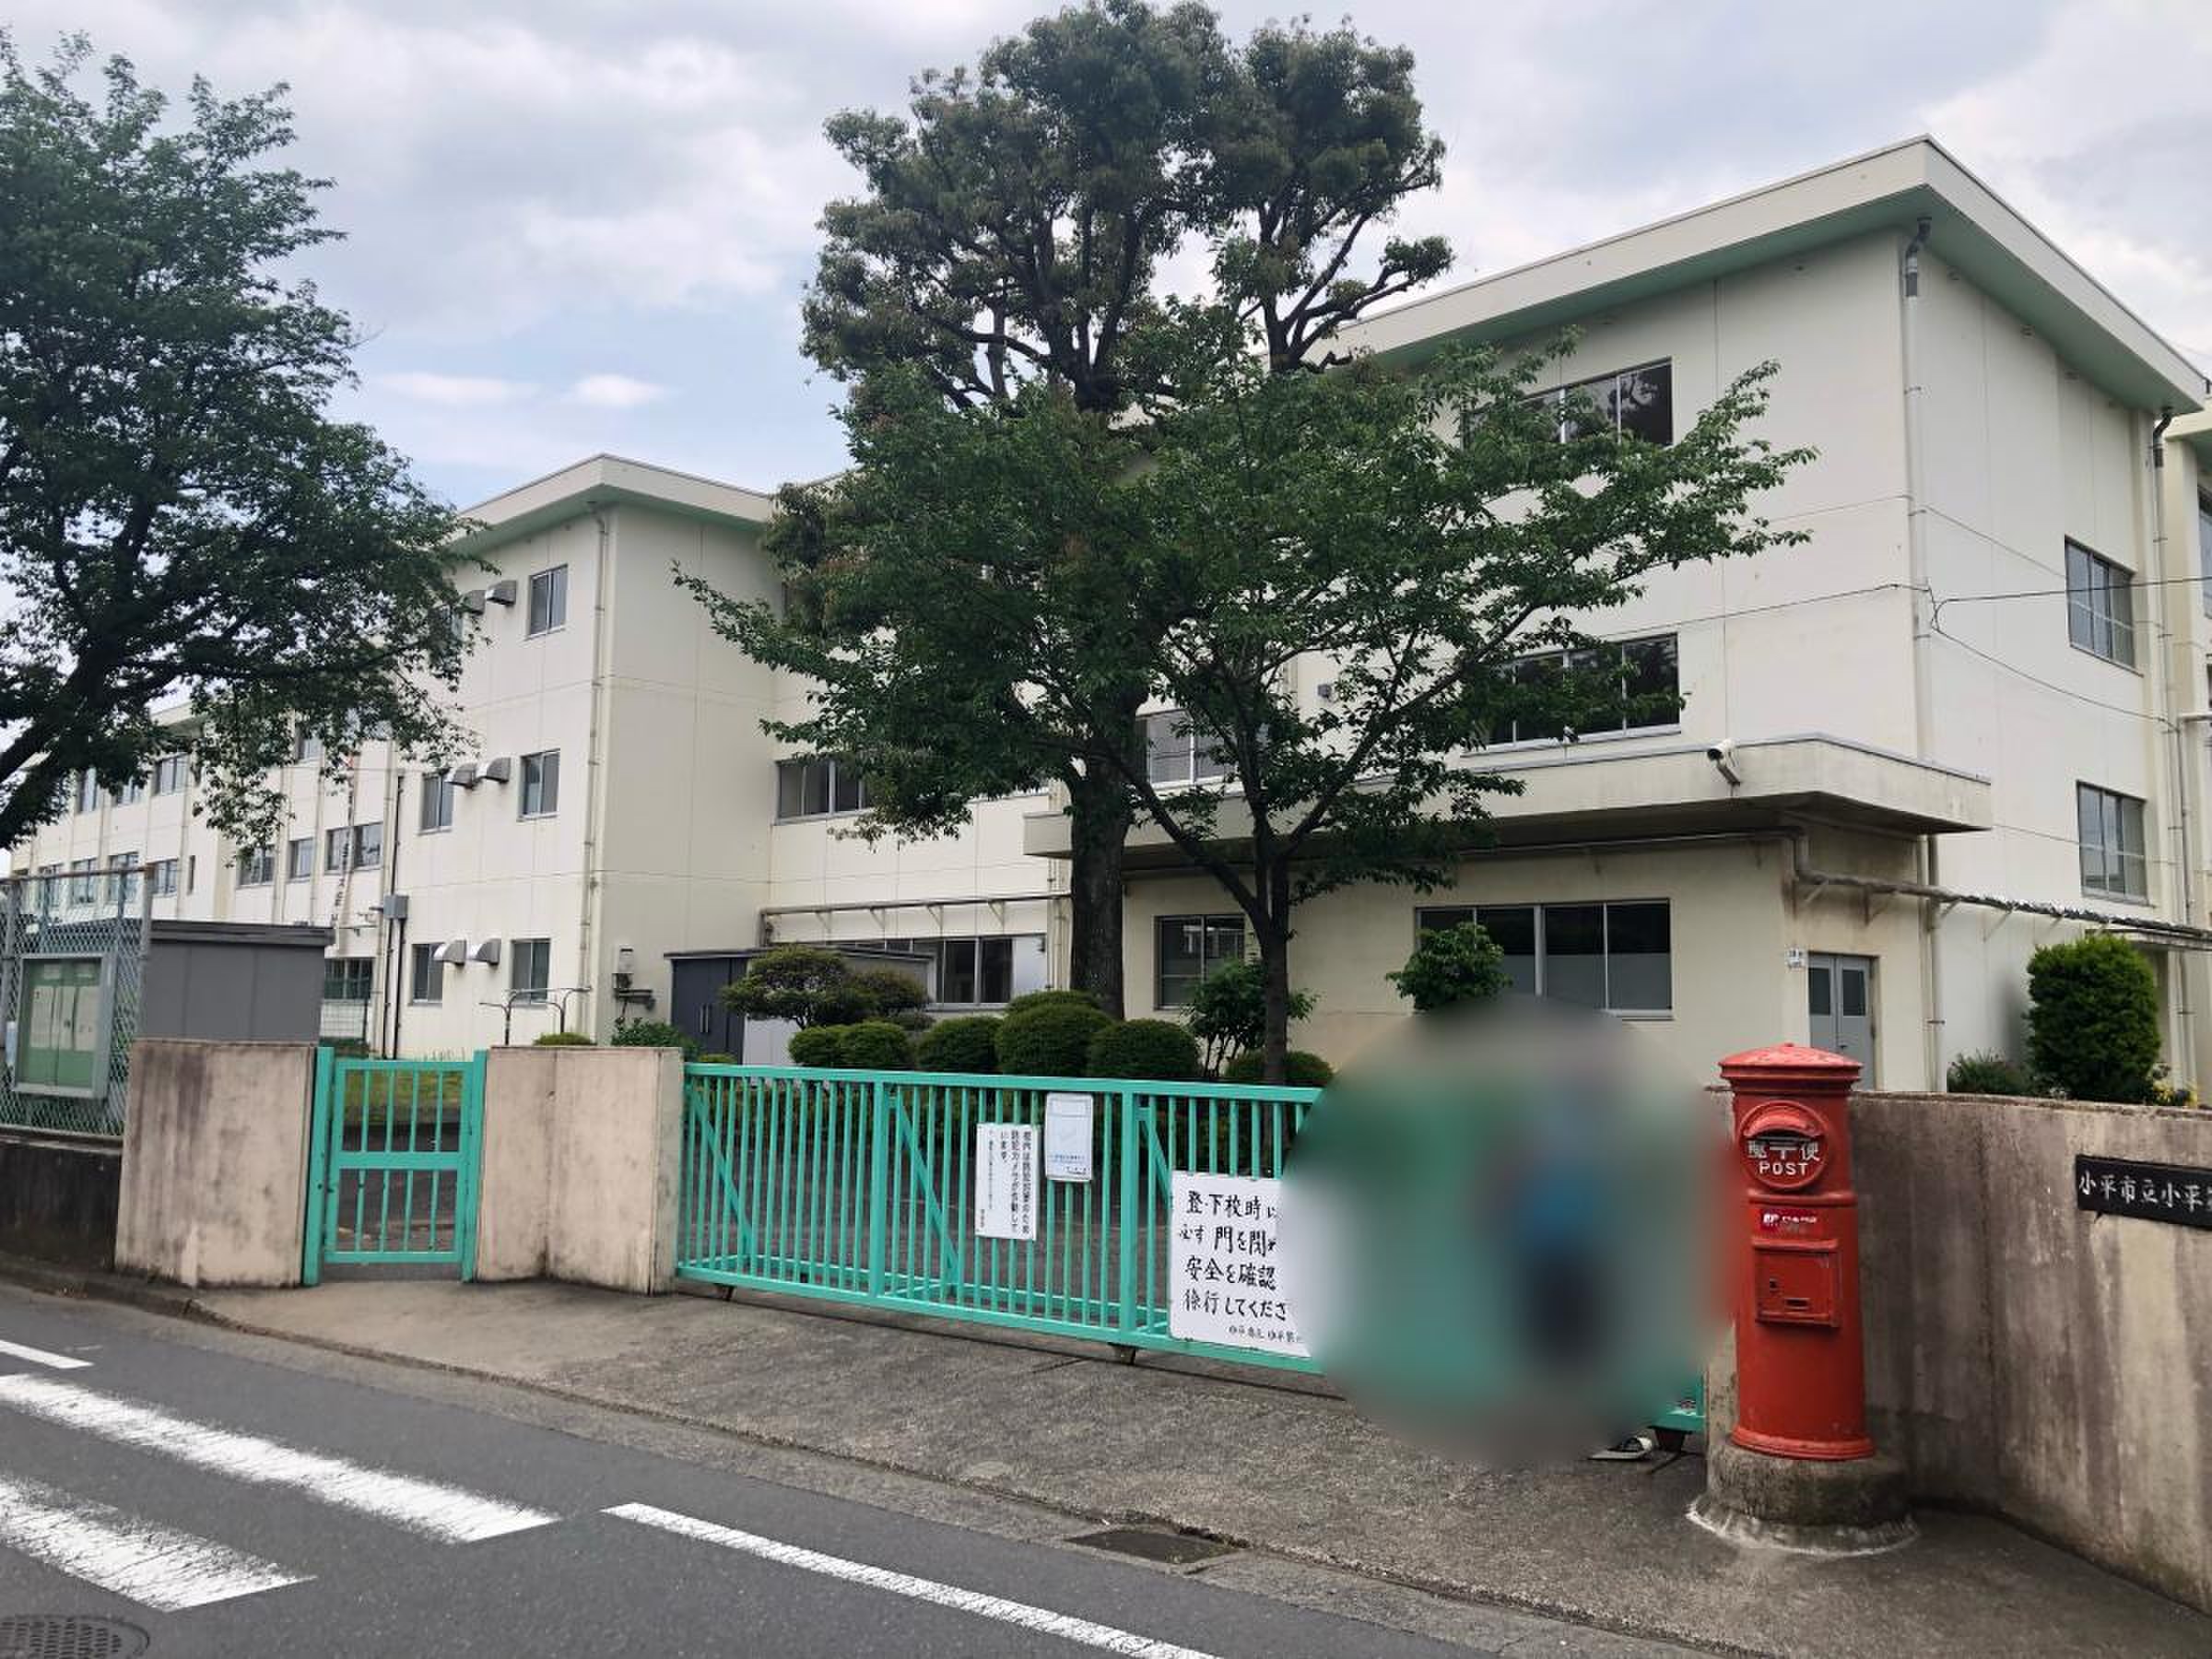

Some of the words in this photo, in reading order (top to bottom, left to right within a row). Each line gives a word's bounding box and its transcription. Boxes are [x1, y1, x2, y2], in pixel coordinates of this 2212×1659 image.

[1759, 1161, 1809, 1176] POST
[1184, 1254, 1277, 1291] 安全を確認
